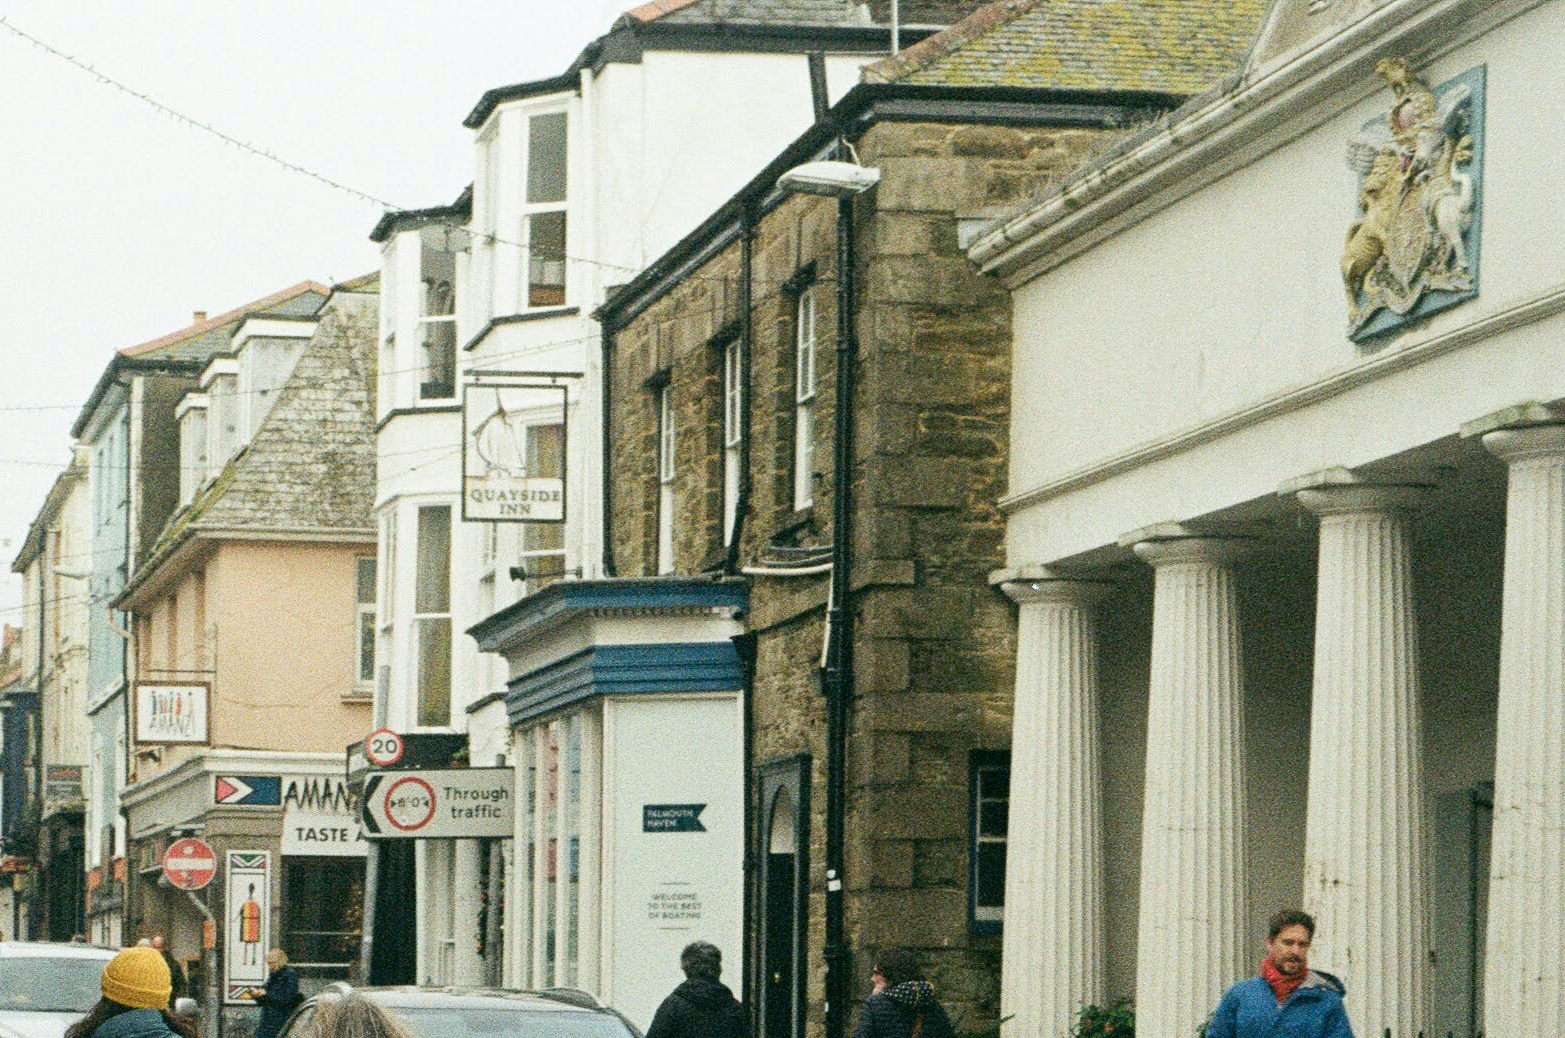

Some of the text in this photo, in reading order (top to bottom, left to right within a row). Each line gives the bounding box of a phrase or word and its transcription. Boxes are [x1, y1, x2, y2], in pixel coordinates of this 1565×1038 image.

[470, 488, 561, 503] QUAYSIDE
[499, 504, 532, 515] INN
[372, 739, 398, 755] 20
[443, 786, 509, 802] Through
[451, 804, 502, 819] traffic
[296, 826, 349, 843] TASTE
[653, 893, 697, 901] WELCOME
